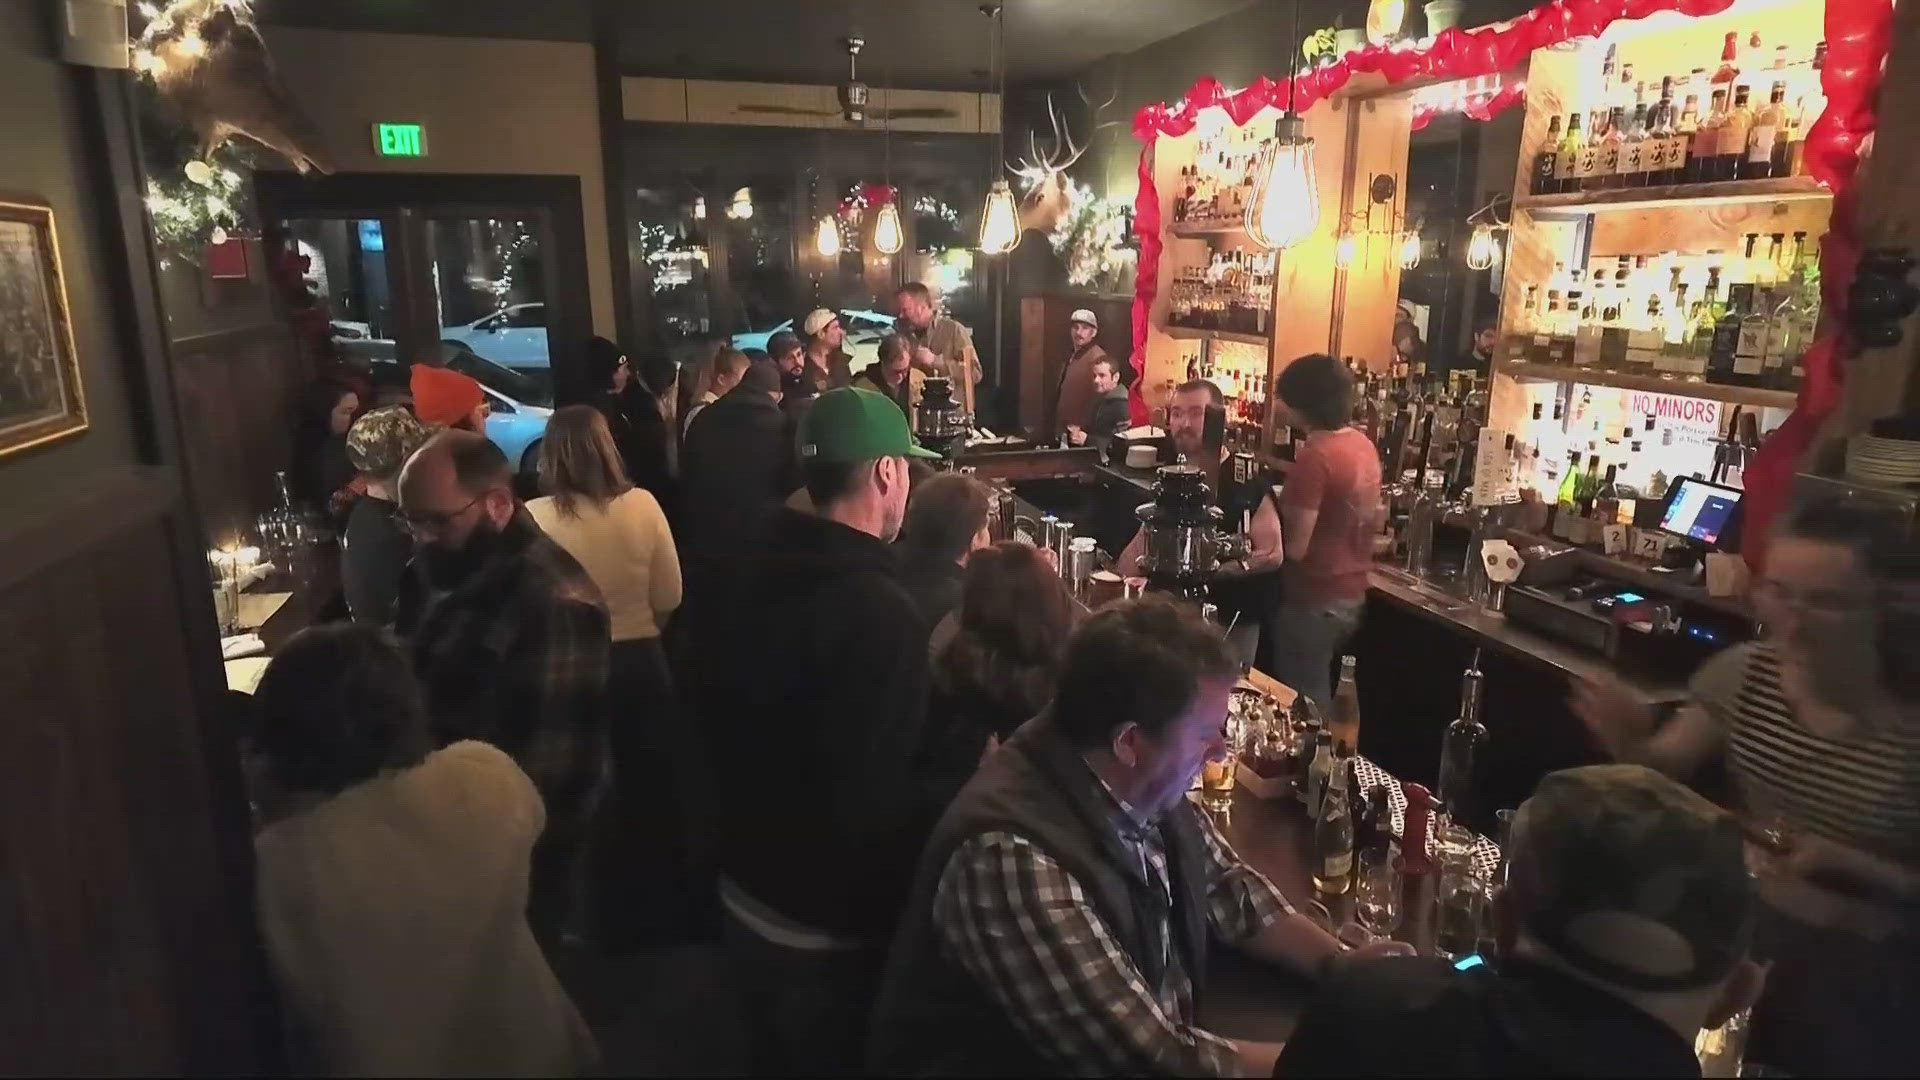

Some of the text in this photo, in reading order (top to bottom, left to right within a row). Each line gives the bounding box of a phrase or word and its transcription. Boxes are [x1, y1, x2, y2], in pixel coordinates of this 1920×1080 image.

[380, 124, 421, 155] EXIT
[1633, 394, 1716, 423] NO MINORS
[1611, 530, 1621, 542] 2
[1643, 537, 1658, 551] 71
